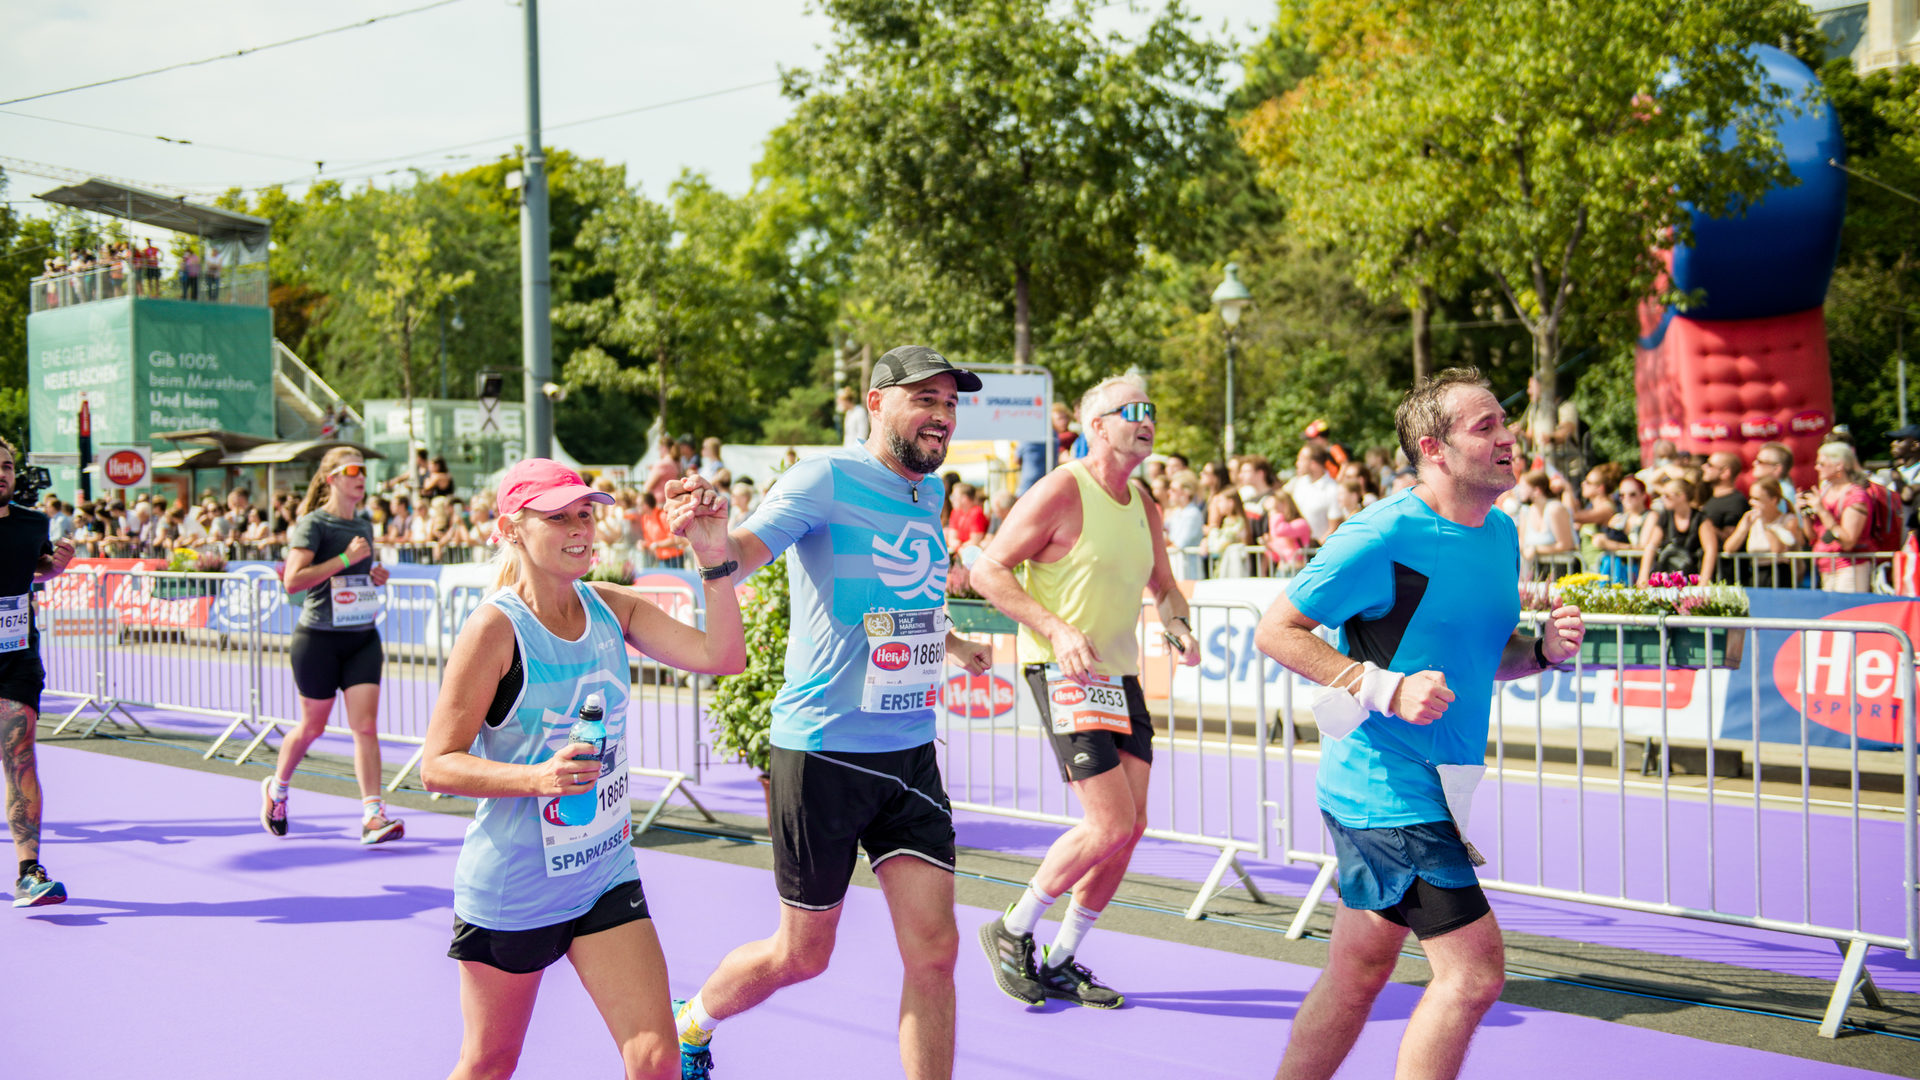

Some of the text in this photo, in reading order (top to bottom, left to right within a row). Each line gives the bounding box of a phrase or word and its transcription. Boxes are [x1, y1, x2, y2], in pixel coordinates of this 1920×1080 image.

[149, 350, 219, 370] Gib 100%
[149, 371, 184, 388] beim
[150, 391, 219, 408] Und beim
[108, 458, 144, 478] Hervis
[0, 612, 28, 628] 16745
[876, 649, 910, 664] Hervis
[913, 641, 945, 665] 18660
[881, 692, 924, 711] ERSTE
[948, 683, 1012, 709] Hervis
[1055, 689, 1085, 702] Hervis
[1088, 687, 1124, 708] 2853
[599, 771, 628, 811] 18661
[551, 829, 623, 871] SPARKASSE
